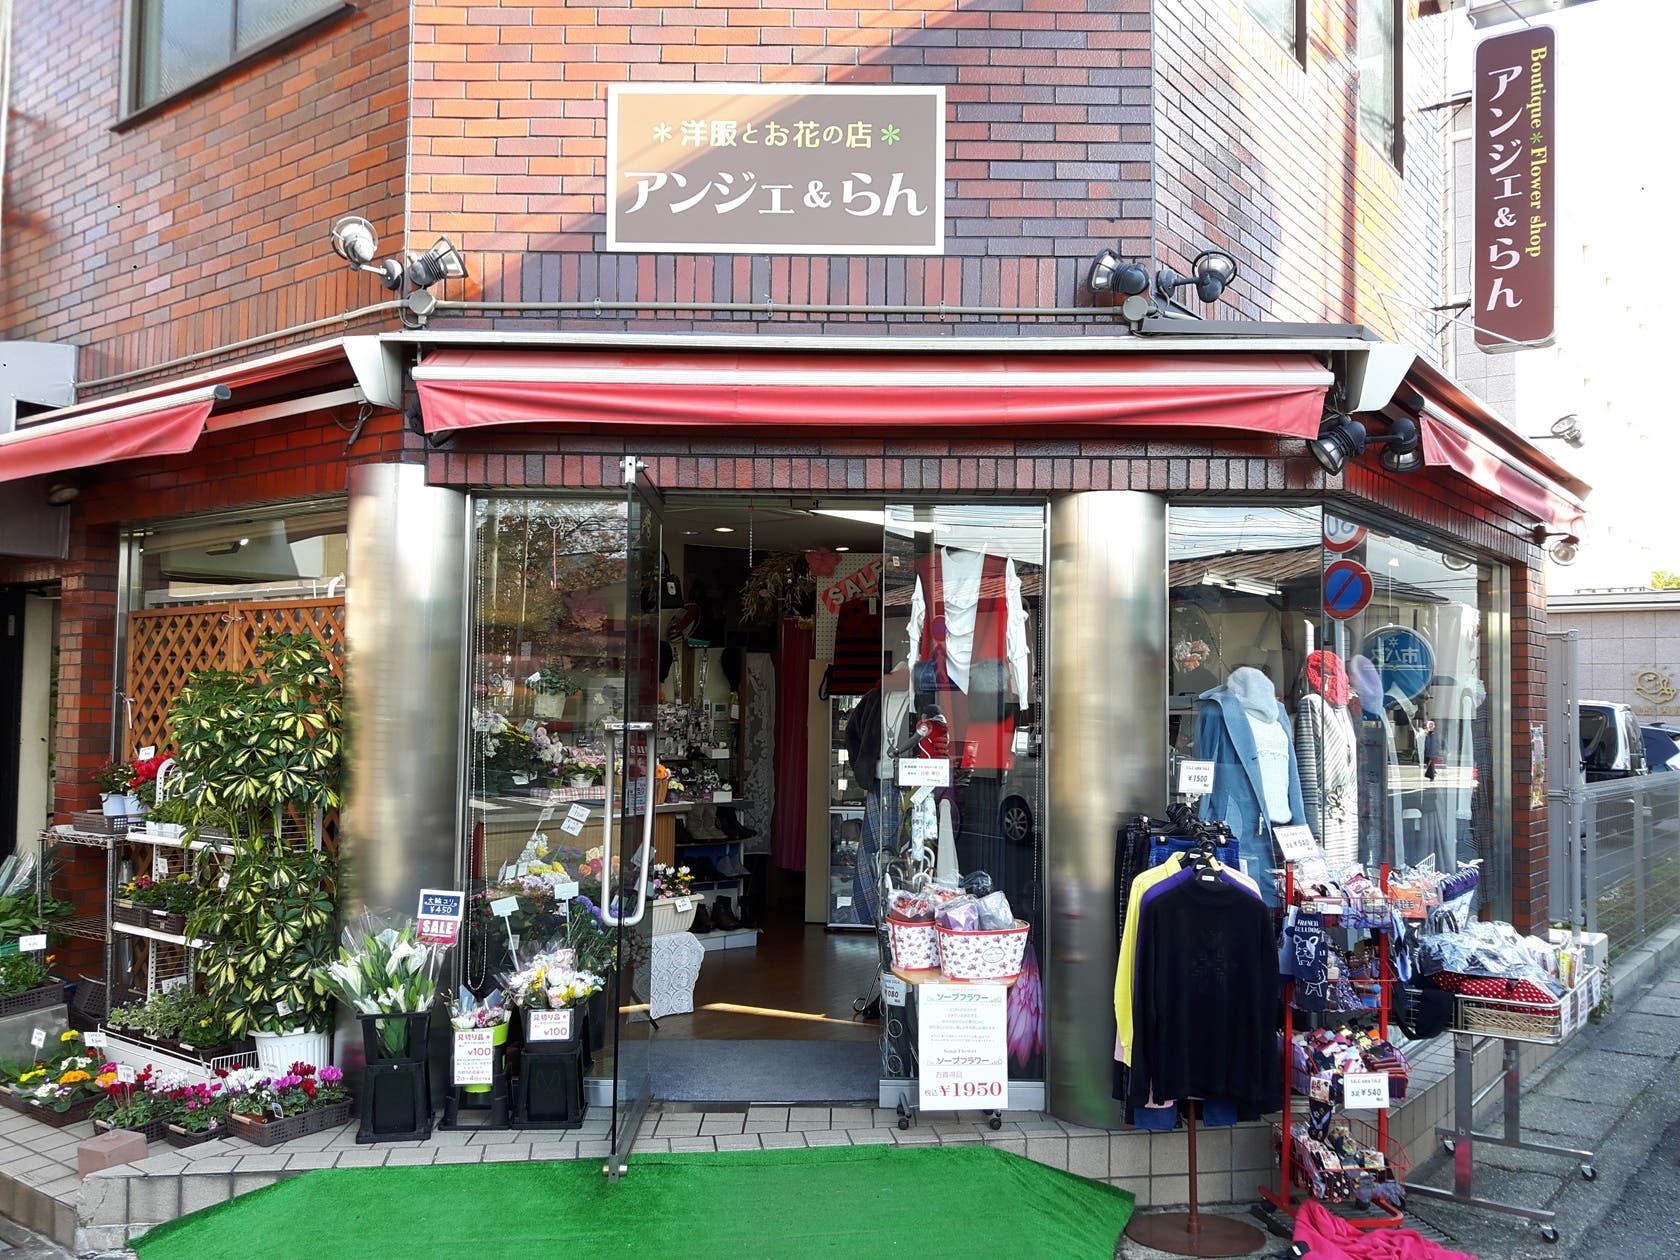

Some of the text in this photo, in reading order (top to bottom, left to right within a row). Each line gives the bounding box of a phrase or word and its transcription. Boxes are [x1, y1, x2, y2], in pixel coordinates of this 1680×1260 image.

[680, 119, 873, 149] 洋服とお花の店
[1526, 46, 1547, 258] Boutique Flower shop
[623, 171, 929, 217] アンジェ&らん
[1486, 65, 1523, 311] アンジェ&らん
[430, 906, 453, 914] ¥450
[422, 919, 454, 935] SALE
[937, 993, 989, 1002] ソープフラワー
[544, 1027, 568, 1036] ¥100
[468, 1047, 491, 1056] ¥100
[937, 1056, 990, 1065] ソープフラワー
[939, 1081, 1003, 1097] ¥1950
